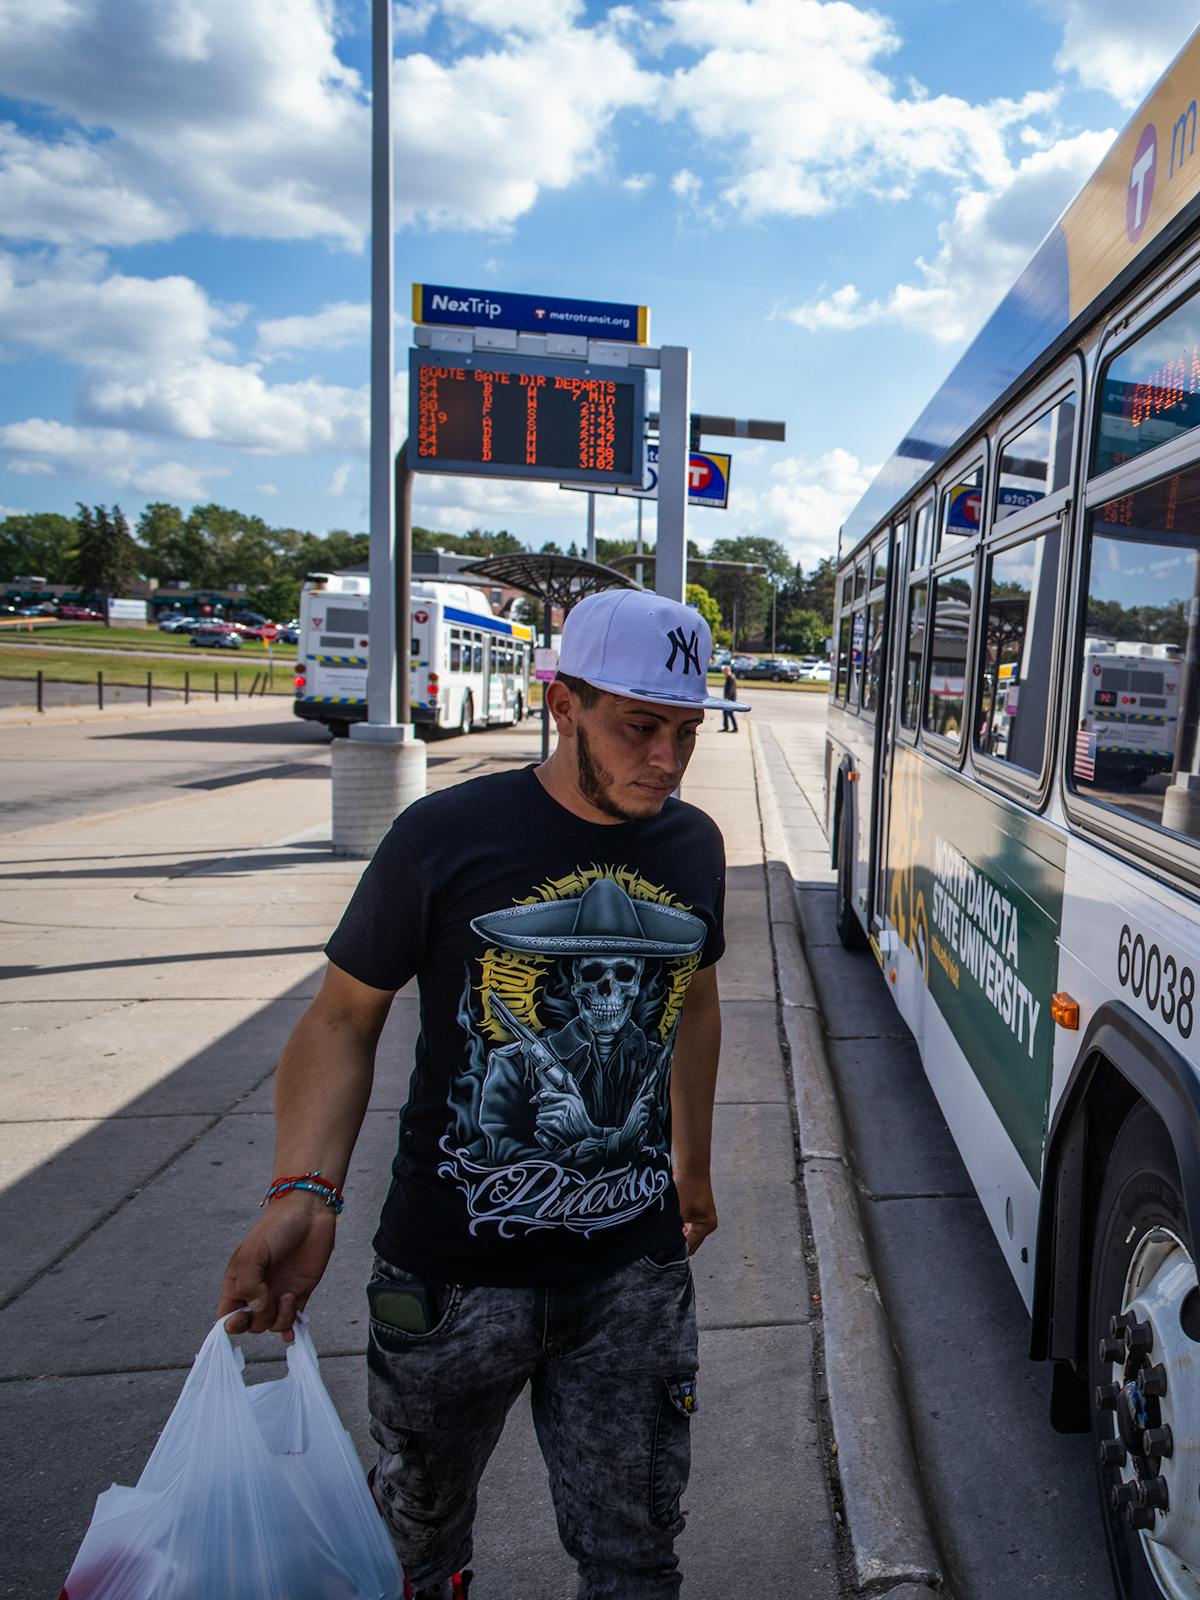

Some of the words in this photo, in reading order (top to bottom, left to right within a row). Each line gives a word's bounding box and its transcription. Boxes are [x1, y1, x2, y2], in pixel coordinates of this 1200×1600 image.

[1131, 141, 1156, 231] T
[431, 294, 502, 320] NexTrip
[549, 310, 630, 328] metrotransit.org
[419, 365, 466, 381] ROUTE
[474, 370, 511, 385] GATE
[519, 374, 546, 388] DIR
[554, 377, 617, 394] DEPARTS
[572, 390, 582, 402] 7
[934, 834, 968, 906] NORTH
[968, 865, 1020, 970] DAKOTA
[932, 883, 959, 953] STATE
[959, 911, 1041, 1059] UNIVERSITY
[1117, 923, 1195, 1040] 60038
